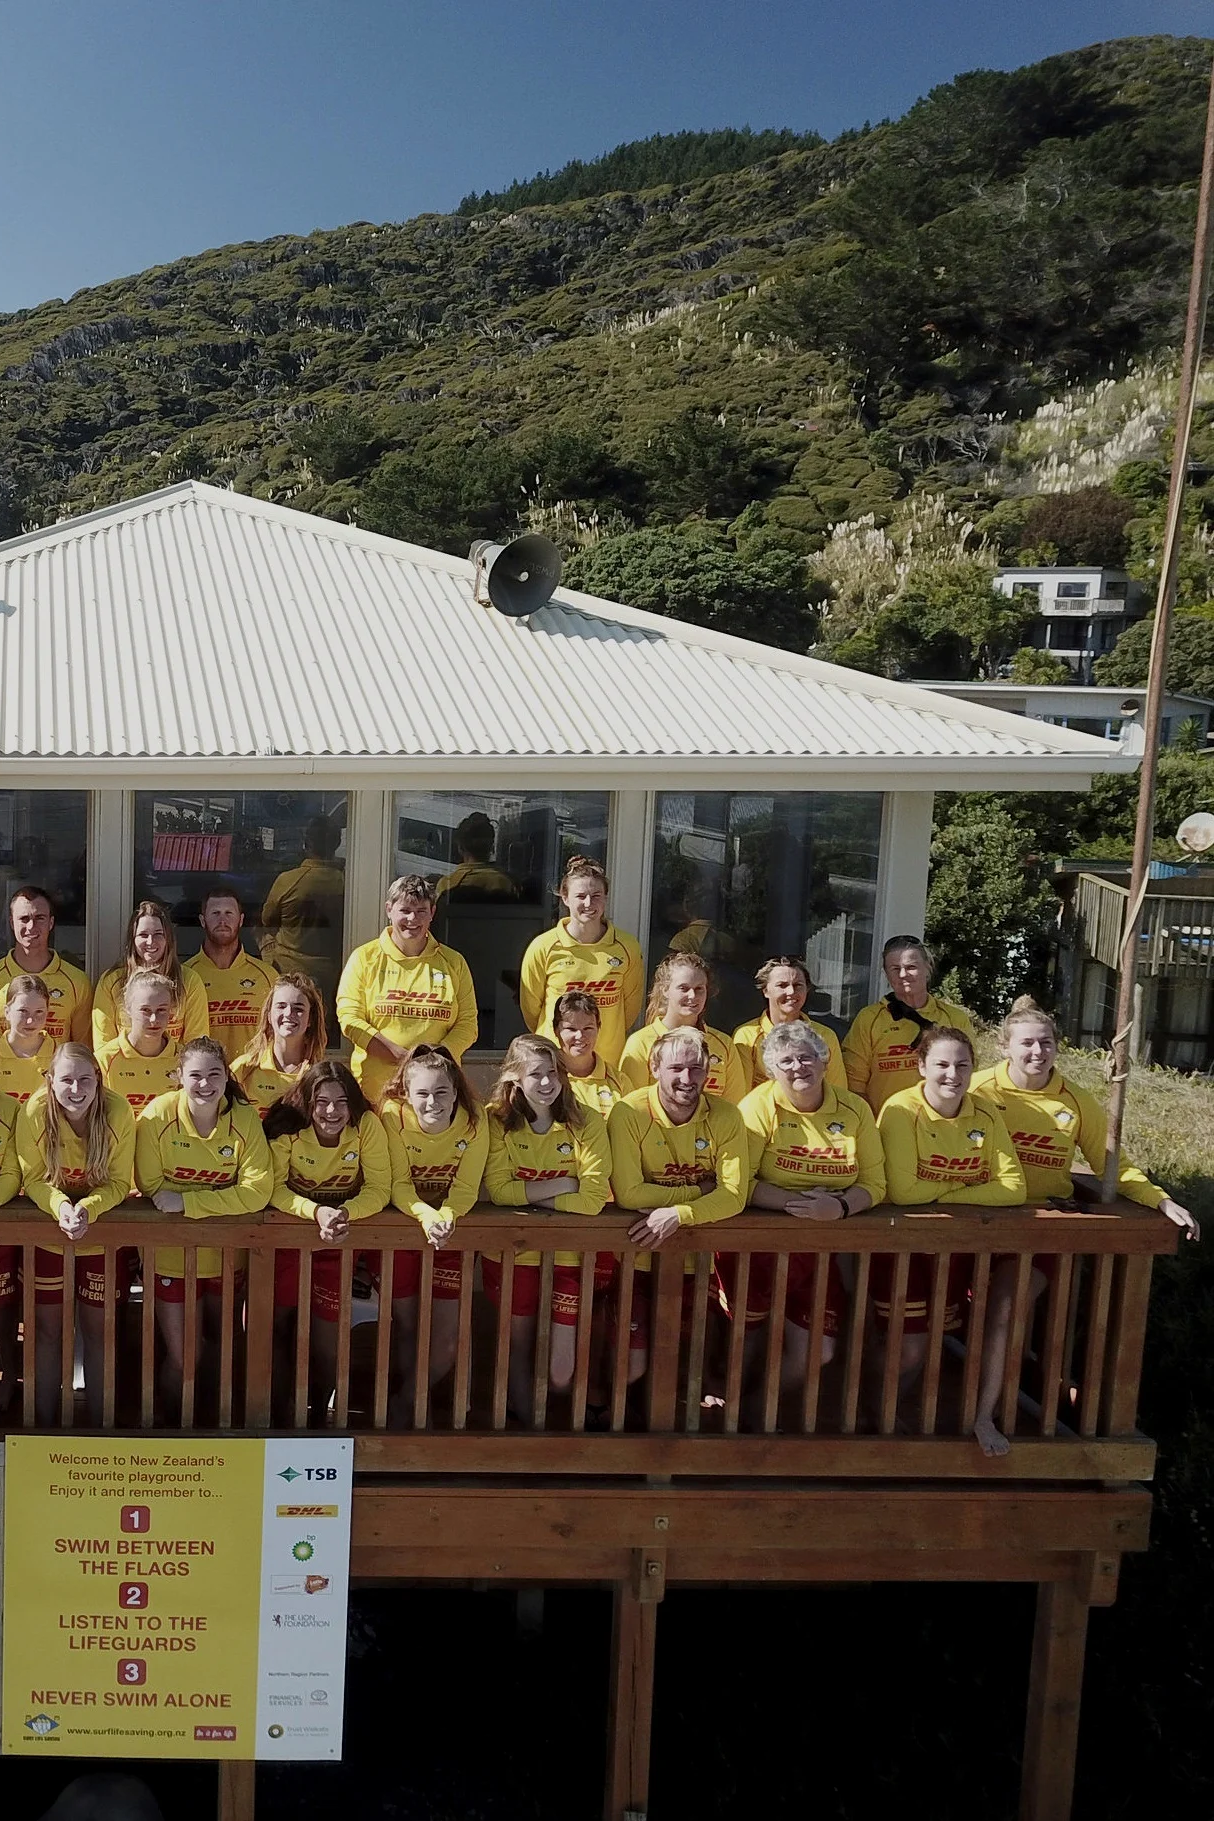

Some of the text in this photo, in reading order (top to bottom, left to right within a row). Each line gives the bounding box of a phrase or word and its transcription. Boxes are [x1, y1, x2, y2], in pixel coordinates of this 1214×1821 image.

[566, 980, 618, 992] DHL
[386, 989, 443, 1004] DHL
[208, 1000, 252, 1011] DHL
[375, 1005, 452, 1019] SURF LIFEGUARD
[879, 1061, 902, 1070] SURF
[1011, 1131, 1056, 1151] HL
[789, 1145, 847, 1160] DHL
[775, 1157, 803, 1171] SURF
[930, 1153, 981, 1170] DHL
[174, 1166, 231, 1183] DHL
[917, 1168, 942, 1181] SURF
[49, 1453, 225, 1467] Welcome to New Zealand's
[68, 1469, 205, 1484] favourite playground.
[304, 1468, 337, 1481] TSB
[49, 1485, 223, 1499] Enjoy it and remember to...
[286, 1507, 324, 1515] DHL
[129, 1511, 140, 1529] 1
[306, 1534, 316, 1542] bp
[54, 1539, 215, 1556] SWIM BETWEEN
[79, 1560, 190, 1577] THE FLAGS
[126, 1587, 141, 1605] 2
[59, 1615, 208, 1631] LISTEN TO THE
[69, 1636, 197, 1652] LIFEGUARDS
[125, 1663, 139, 1681] 3
[31, 1690, 232, 1708] NEVER SWIM ALONE
[67, 1727, 186, 1738] www.surflifesaving.org.nz
